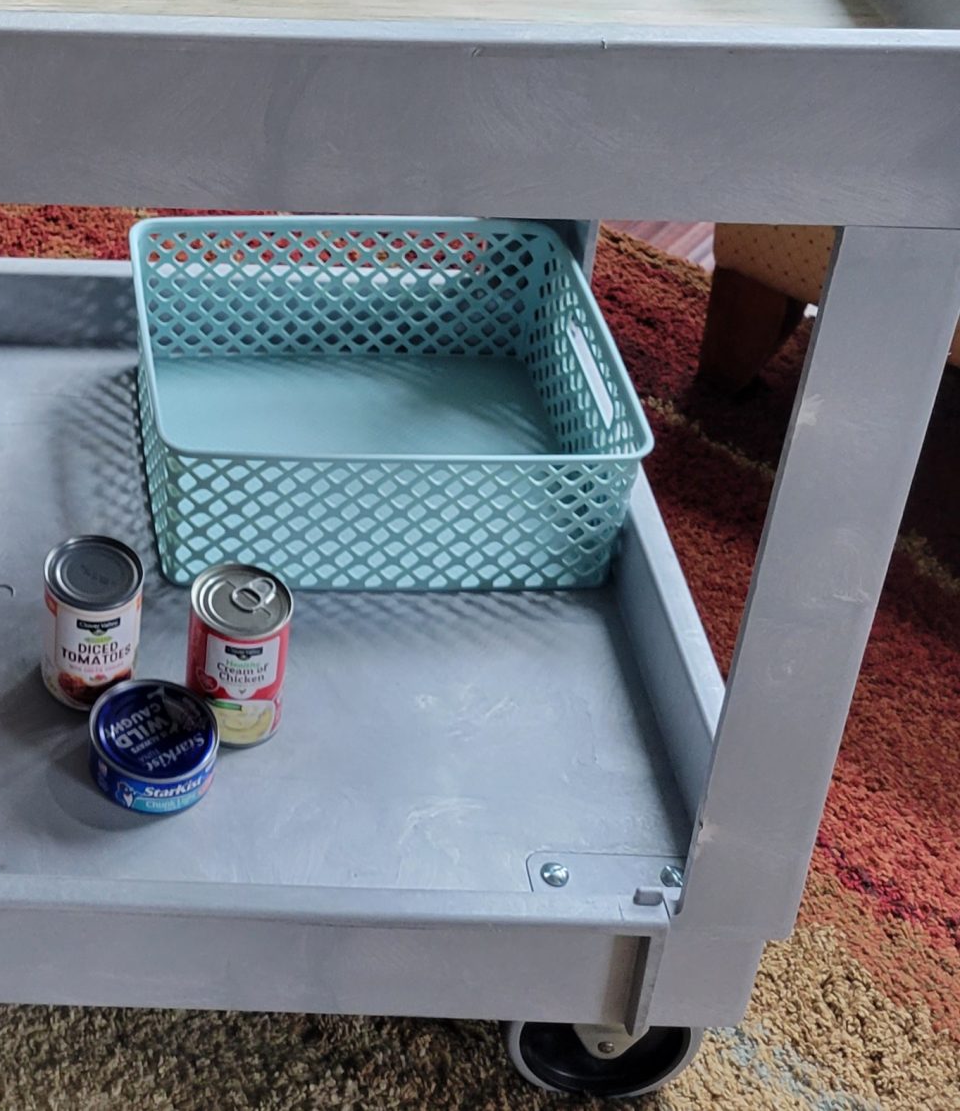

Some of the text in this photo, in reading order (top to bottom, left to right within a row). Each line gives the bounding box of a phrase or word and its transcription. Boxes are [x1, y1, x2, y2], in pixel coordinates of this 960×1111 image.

[62, 643, 132, 666] TOMATOES
[78, 641, 118, 655] DICED
[217, 662, 254, 675] Cream
[219, 671, 265, 683] Chicken
[115, 715, 170, 749] WILD
[145, 732, 206, 772] StarKist
[143, 774, 202, 798] StarKist
